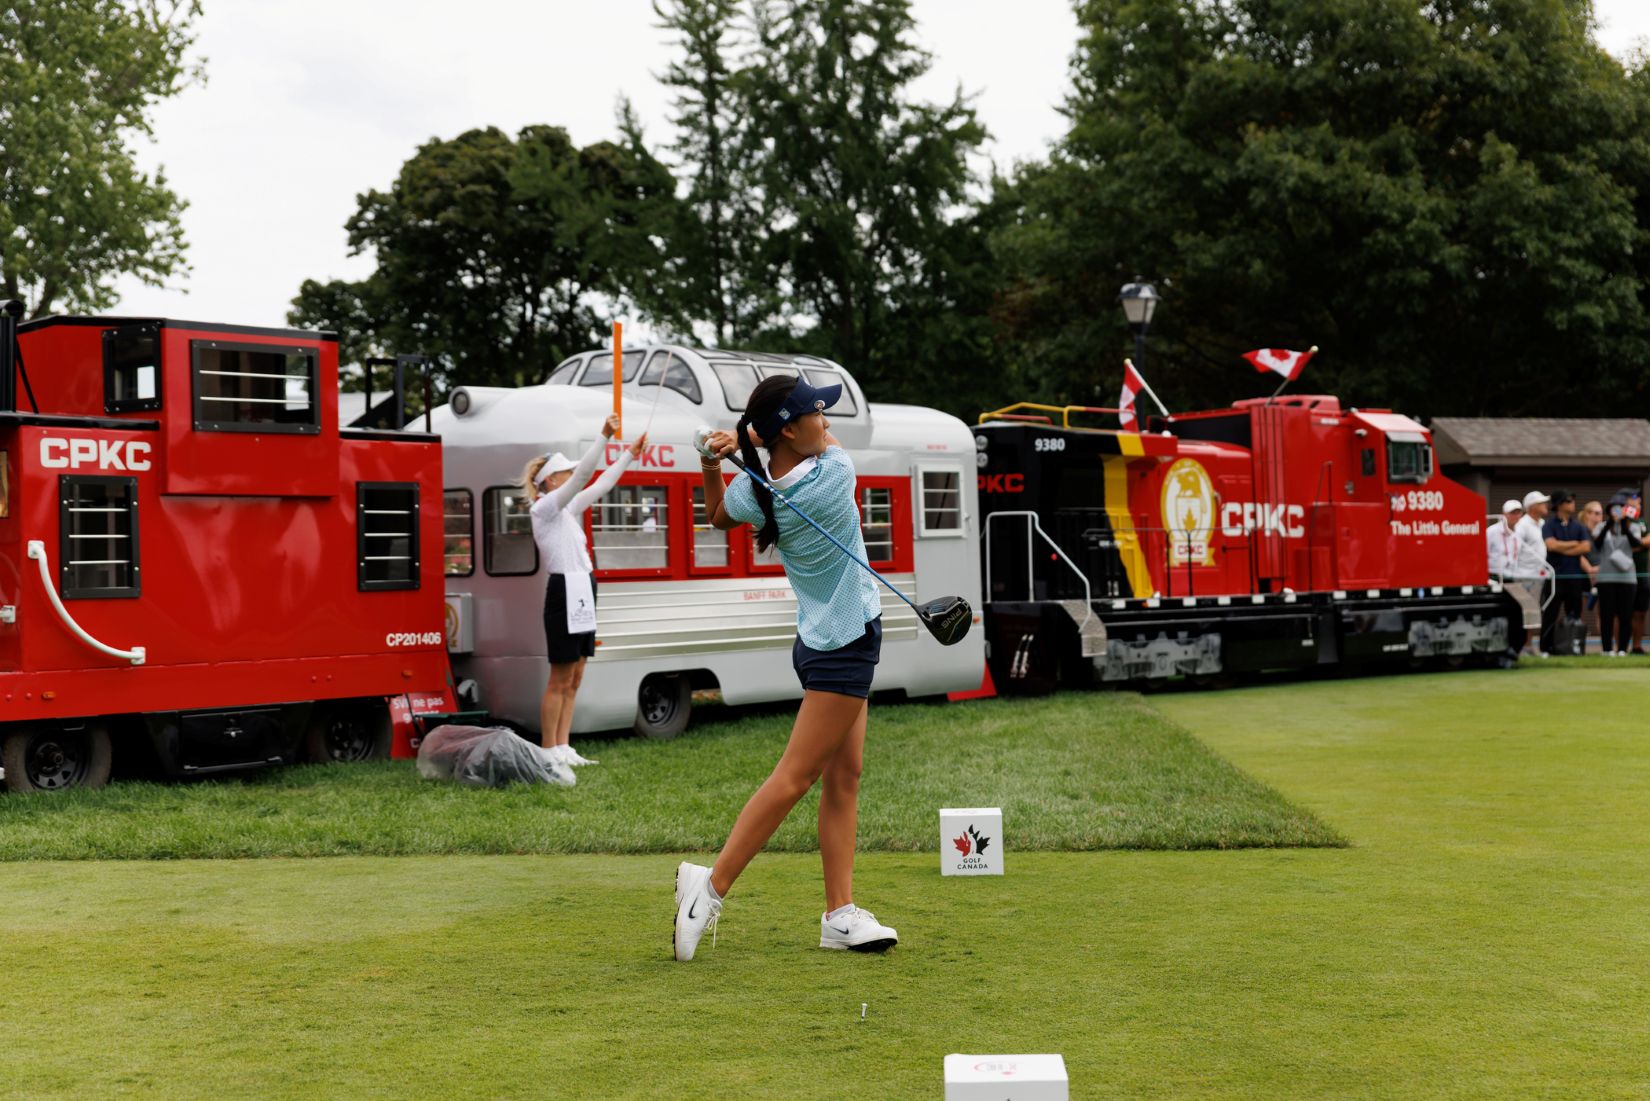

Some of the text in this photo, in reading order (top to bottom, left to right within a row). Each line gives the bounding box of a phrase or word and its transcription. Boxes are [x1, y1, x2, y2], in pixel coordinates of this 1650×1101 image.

[39, 437, 152, 472] CPKC
[605, 443, 675, 468] CKC
[1034, 438, 1066, 452] 9380
[976, 473, 1025, 494] PKC
[1407, 490, 1444, 511] 9380
[1220, 502, 1305, 538] CPKC
[1390, 520, 1480, 535] The Little General
[941, 607, 963, 629] PING
[385, 632, 442, 647] CP201406
